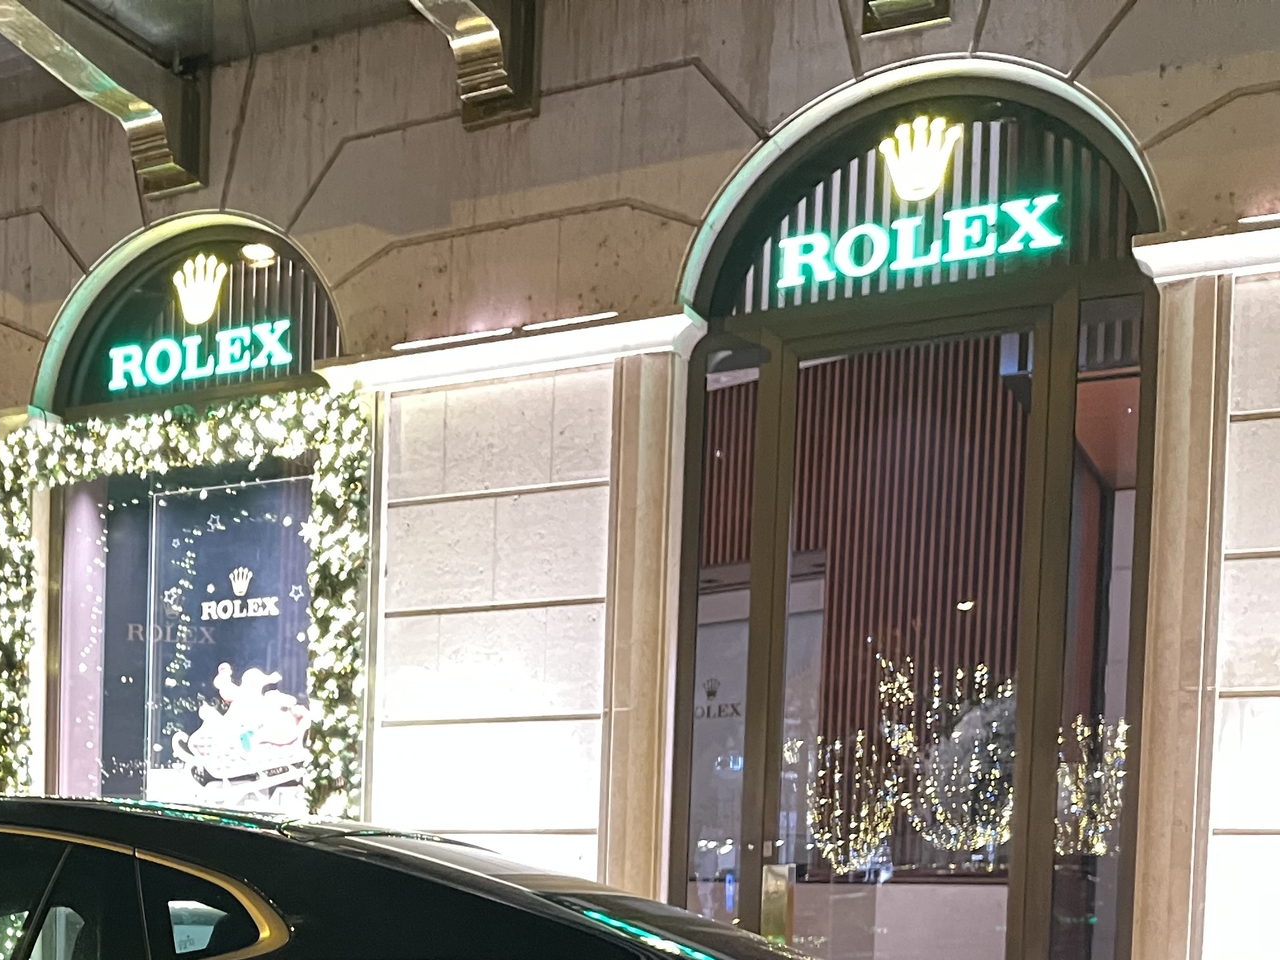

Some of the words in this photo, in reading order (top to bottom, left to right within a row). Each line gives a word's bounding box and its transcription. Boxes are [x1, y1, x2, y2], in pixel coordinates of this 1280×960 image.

[777, 193, 1064, 288] ROLEX
[108, 319, 293, 391] ROLEX
[201, 597, 280, 620] ROLEX
[693, 702, 741, 719] OLEX
